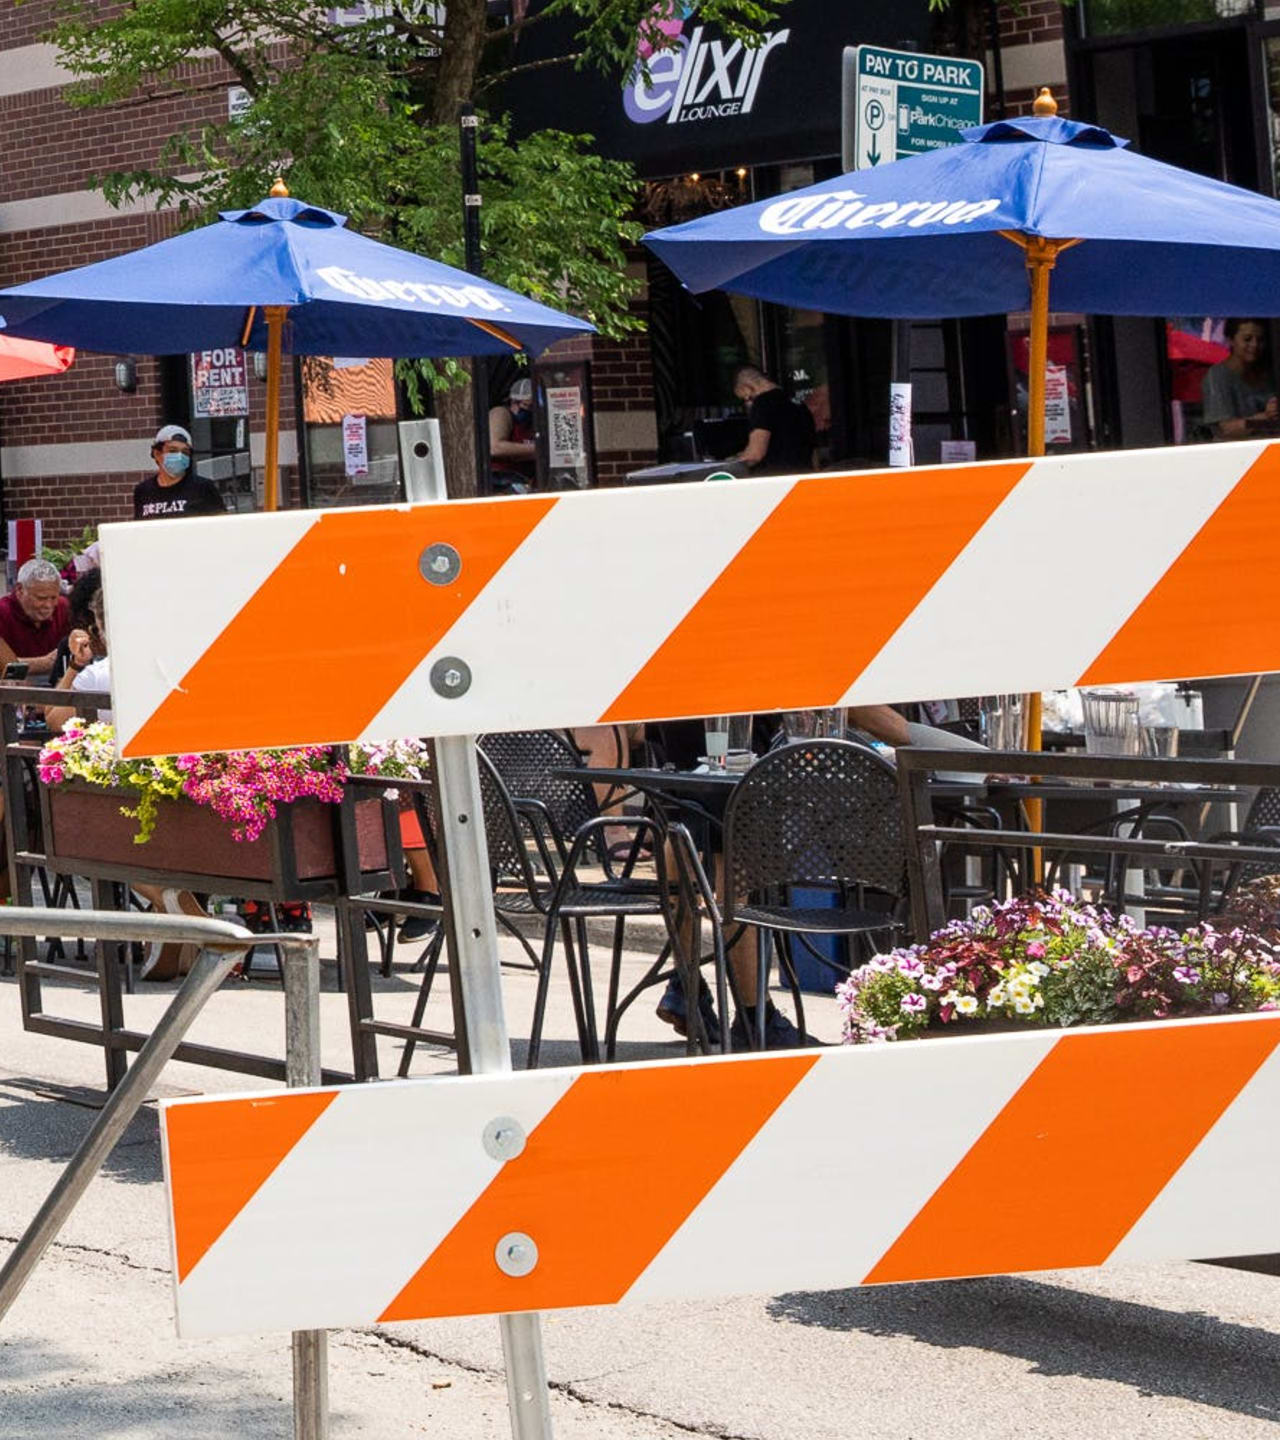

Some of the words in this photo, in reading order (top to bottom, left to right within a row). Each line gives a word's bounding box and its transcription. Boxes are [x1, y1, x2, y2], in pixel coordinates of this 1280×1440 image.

[866, 54, 893, 75] PAY
[895, 59, 918, 79] TO
[923, 63, 972, 86] PARK
[679, 102, 741, 122] LOUNGE
[201, 348, 237, 367] FOR
[196, 367, 243, 388] RENT
